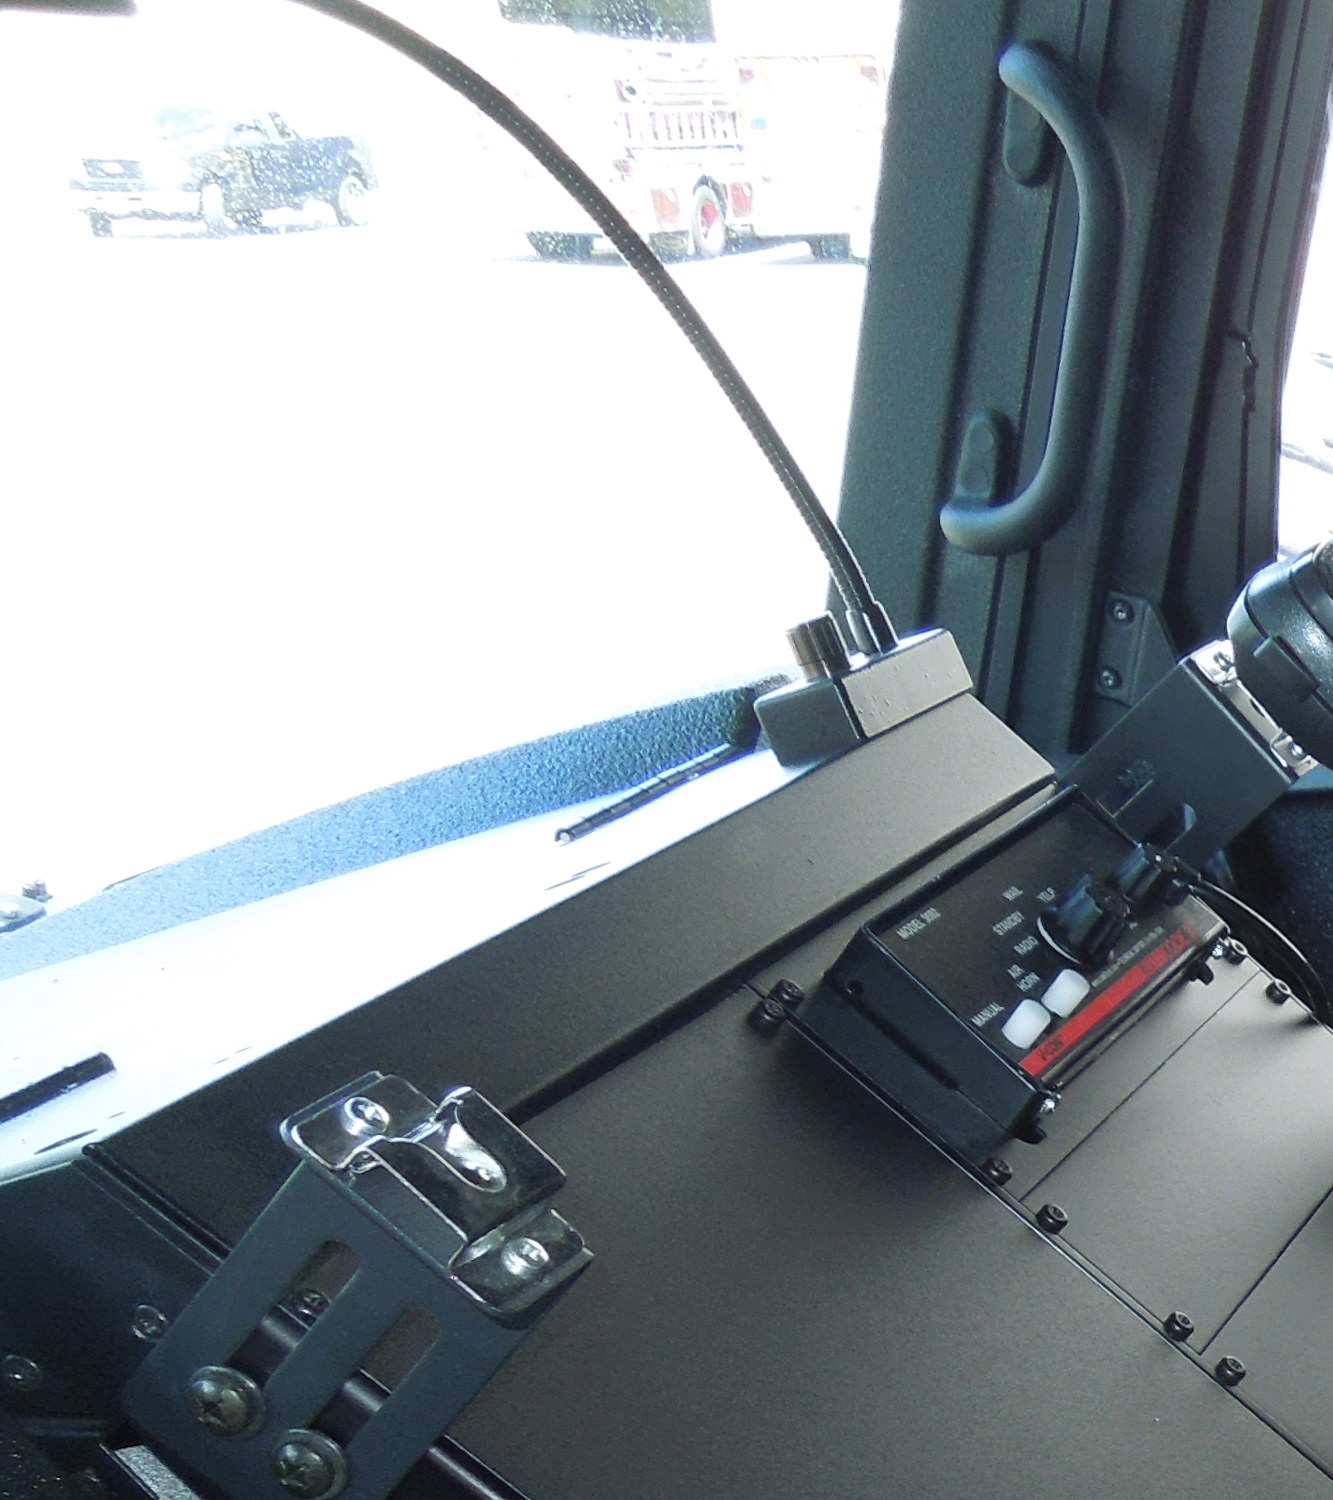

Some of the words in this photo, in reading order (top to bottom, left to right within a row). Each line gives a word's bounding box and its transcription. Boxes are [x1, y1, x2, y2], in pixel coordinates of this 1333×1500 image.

[896, 918, 927, 940] MODEL
[992, 911, 1024, 936] STANDBY
[1013, 935, 1039, 956] RADIO
[1007, 964, 1025, 980] AIR
[1016, 972, 1041, 992] HORN
[971, 1002, 1005, 1027] MANUAL
